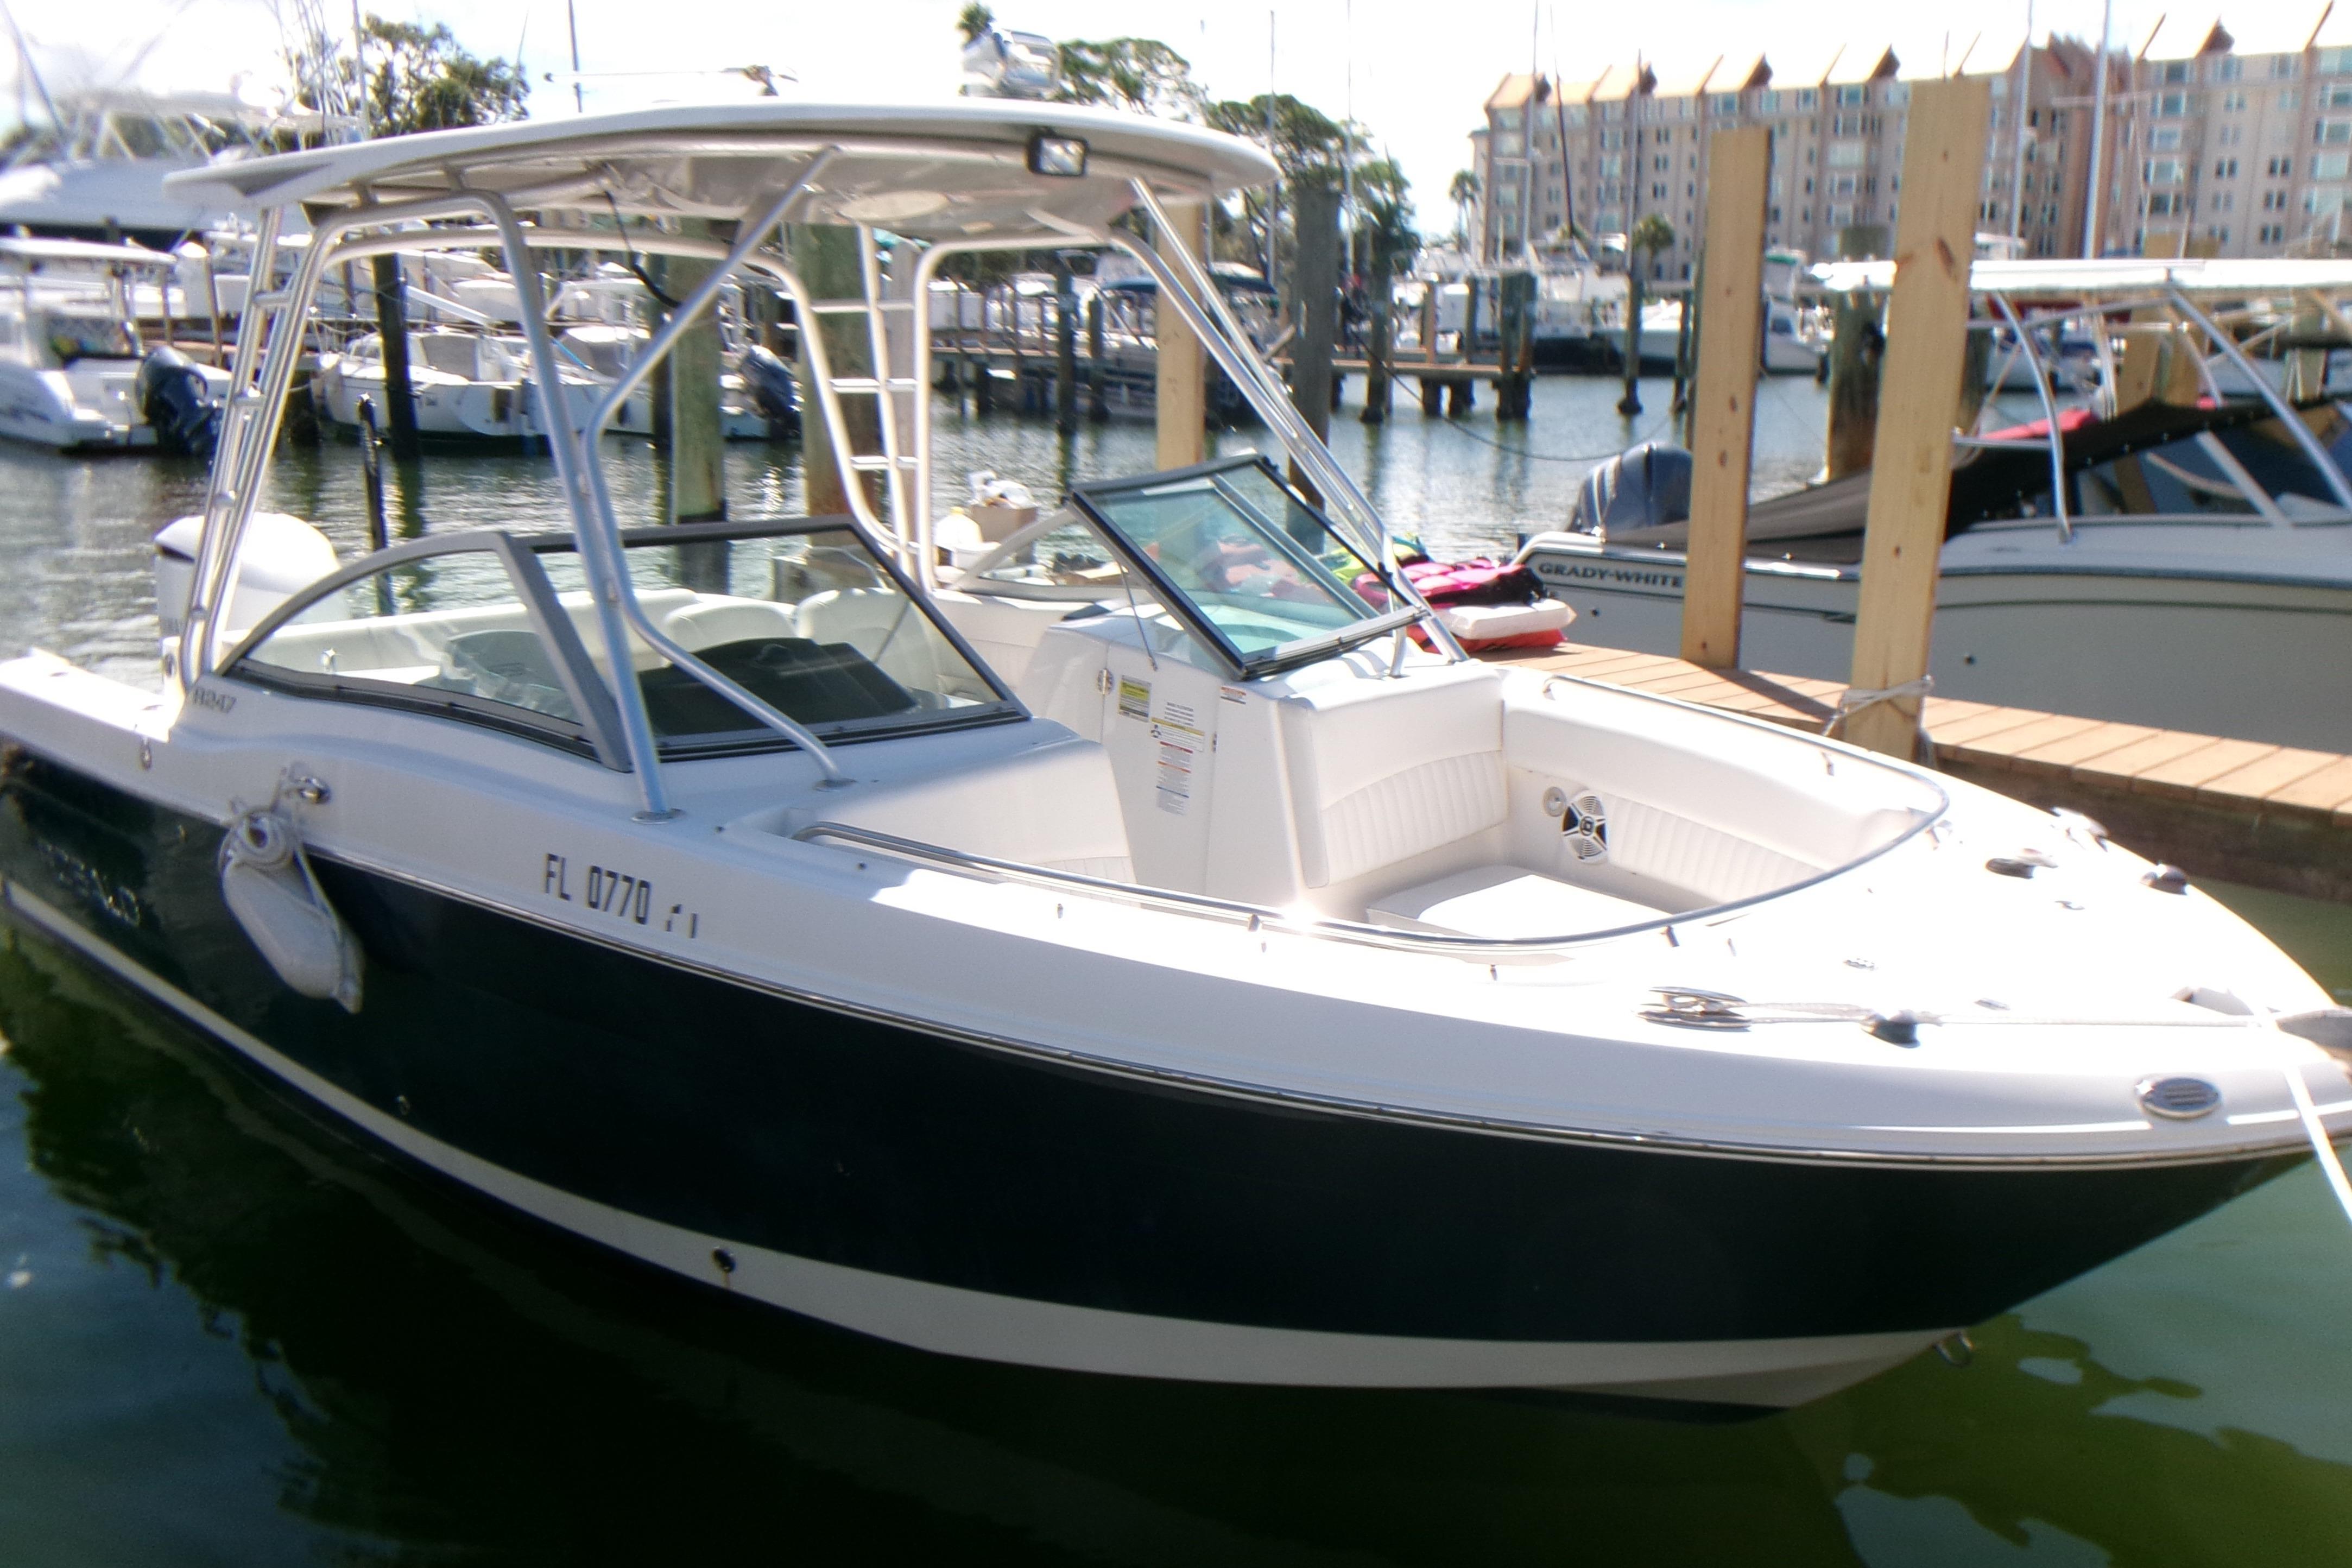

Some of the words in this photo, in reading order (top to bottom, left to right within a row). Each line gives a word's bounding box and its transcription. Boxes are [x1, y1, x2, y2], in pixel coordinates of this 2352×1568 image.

[1539, 562, 1681, 587] GRADY-WHITE
[544, 853, 571, 901] FL
[587, 865, 651, 924] 0770
